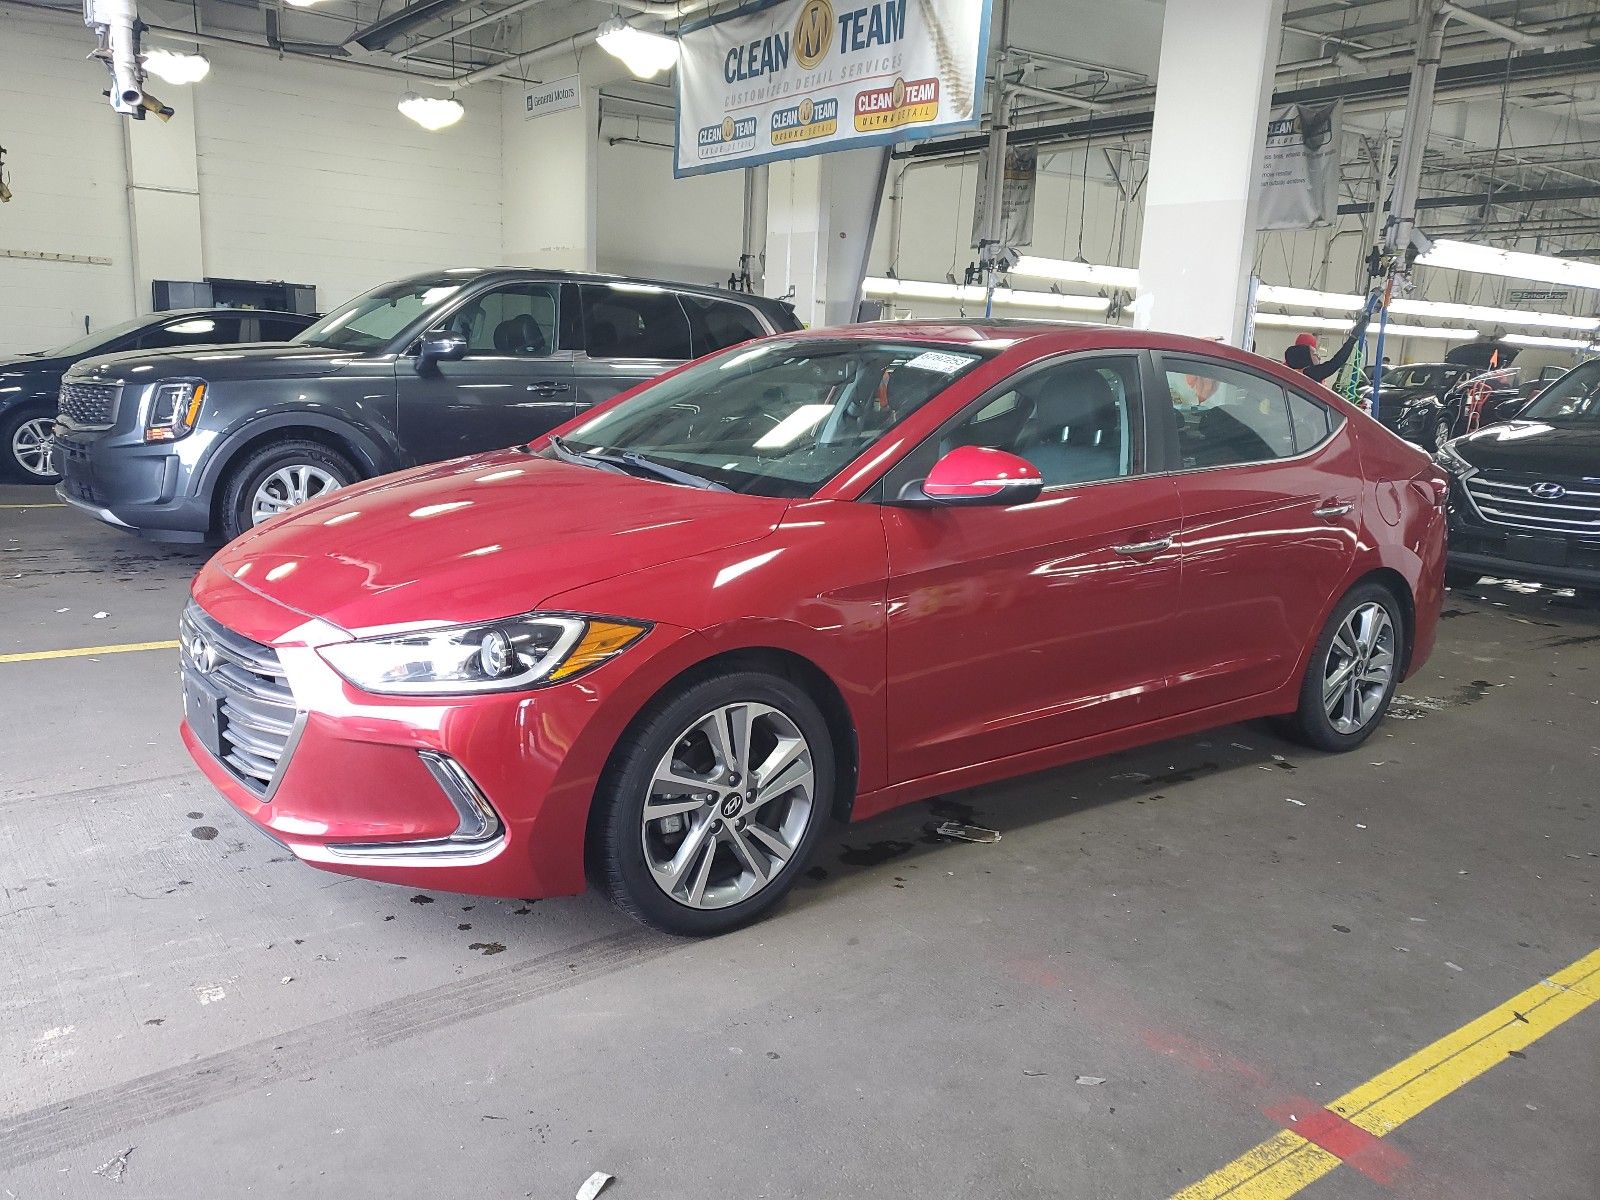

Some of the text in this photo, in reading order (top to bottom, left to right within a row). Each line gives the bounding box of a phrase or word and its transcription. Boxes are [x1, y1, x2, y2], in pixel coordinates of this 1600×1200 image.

[724, 31, 789, 84] CLEAN
[838, 0, 907, 54] TEAM
[725, 53, 903, 107] CUSTOMIZED DETAIL SERVICES
[534, 91, 554, 107] General
[554, 88, 575, 101] Motors
[858, 82, 935, 112] CLEAN TEAM
[772, 101, 836, 129] CLEAN TEAM
[700, 120, 755, 144] CLEAN TEAM
[774, 130, 804, 141] DELUXE
